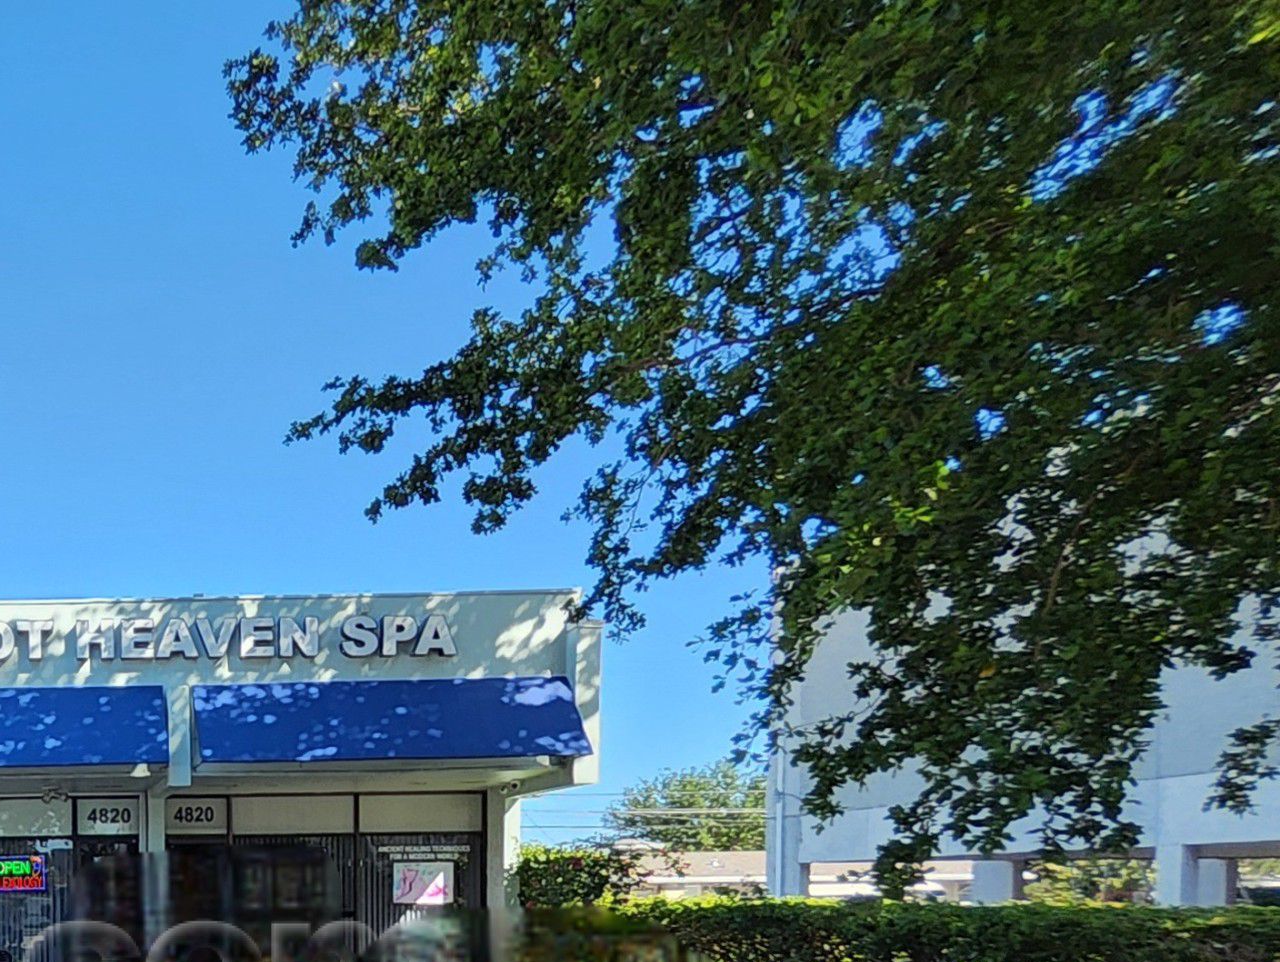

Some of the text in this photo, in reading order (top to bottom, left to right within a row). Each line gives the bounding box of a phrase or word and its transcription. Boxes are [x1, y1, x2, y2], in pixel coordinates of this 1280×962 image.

[76, 615, 319, 660] HEAVEN
[341, 614, 458, 658] SPA
[86, 807, 132, 824] 4820
[173, 806, 215, 823] 4820
